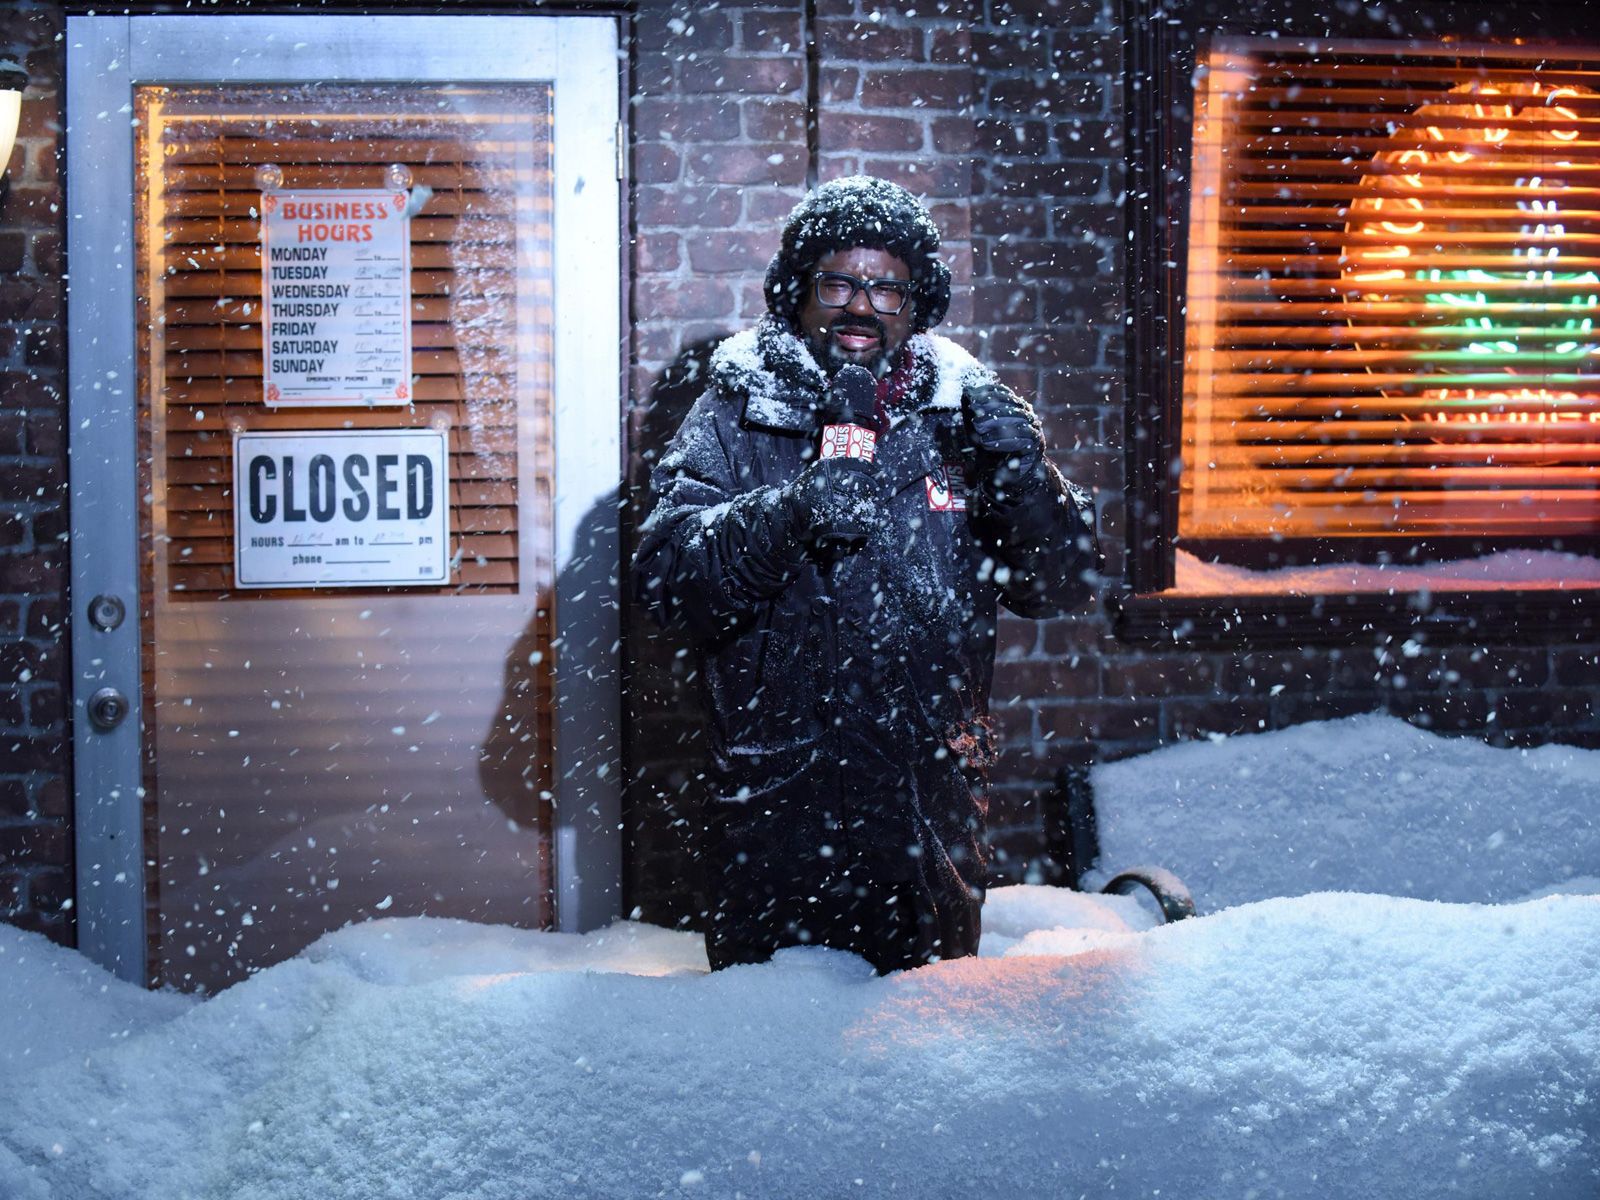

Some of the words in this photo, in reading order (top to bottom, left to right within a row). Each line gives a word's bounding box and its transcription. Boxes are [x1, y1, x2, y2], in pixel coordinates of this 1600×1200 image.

[298, 224, 373, 242] HOURS
[271, 248, 327, 261] MONDAY
[272, 266, 328, 280] TUESDAY
[272, 285, 350, 298] WEDNESDAY
[272, 303, 339, 317] THURSDAY
[272, 322, 316, 336] FRIDAY
[272, 341, 338, 354] SATURDAY
[272, 359, 324, 373] SUNDAY
[250, 453, 433, 524] CLOSED
[251, 536, 285, 547] HOURS
[335, 537, 349, 546] am
[354, 536, 364, 546] to
[419, 536, 433, 545] pm
[292, 554, 322, 565] phone
